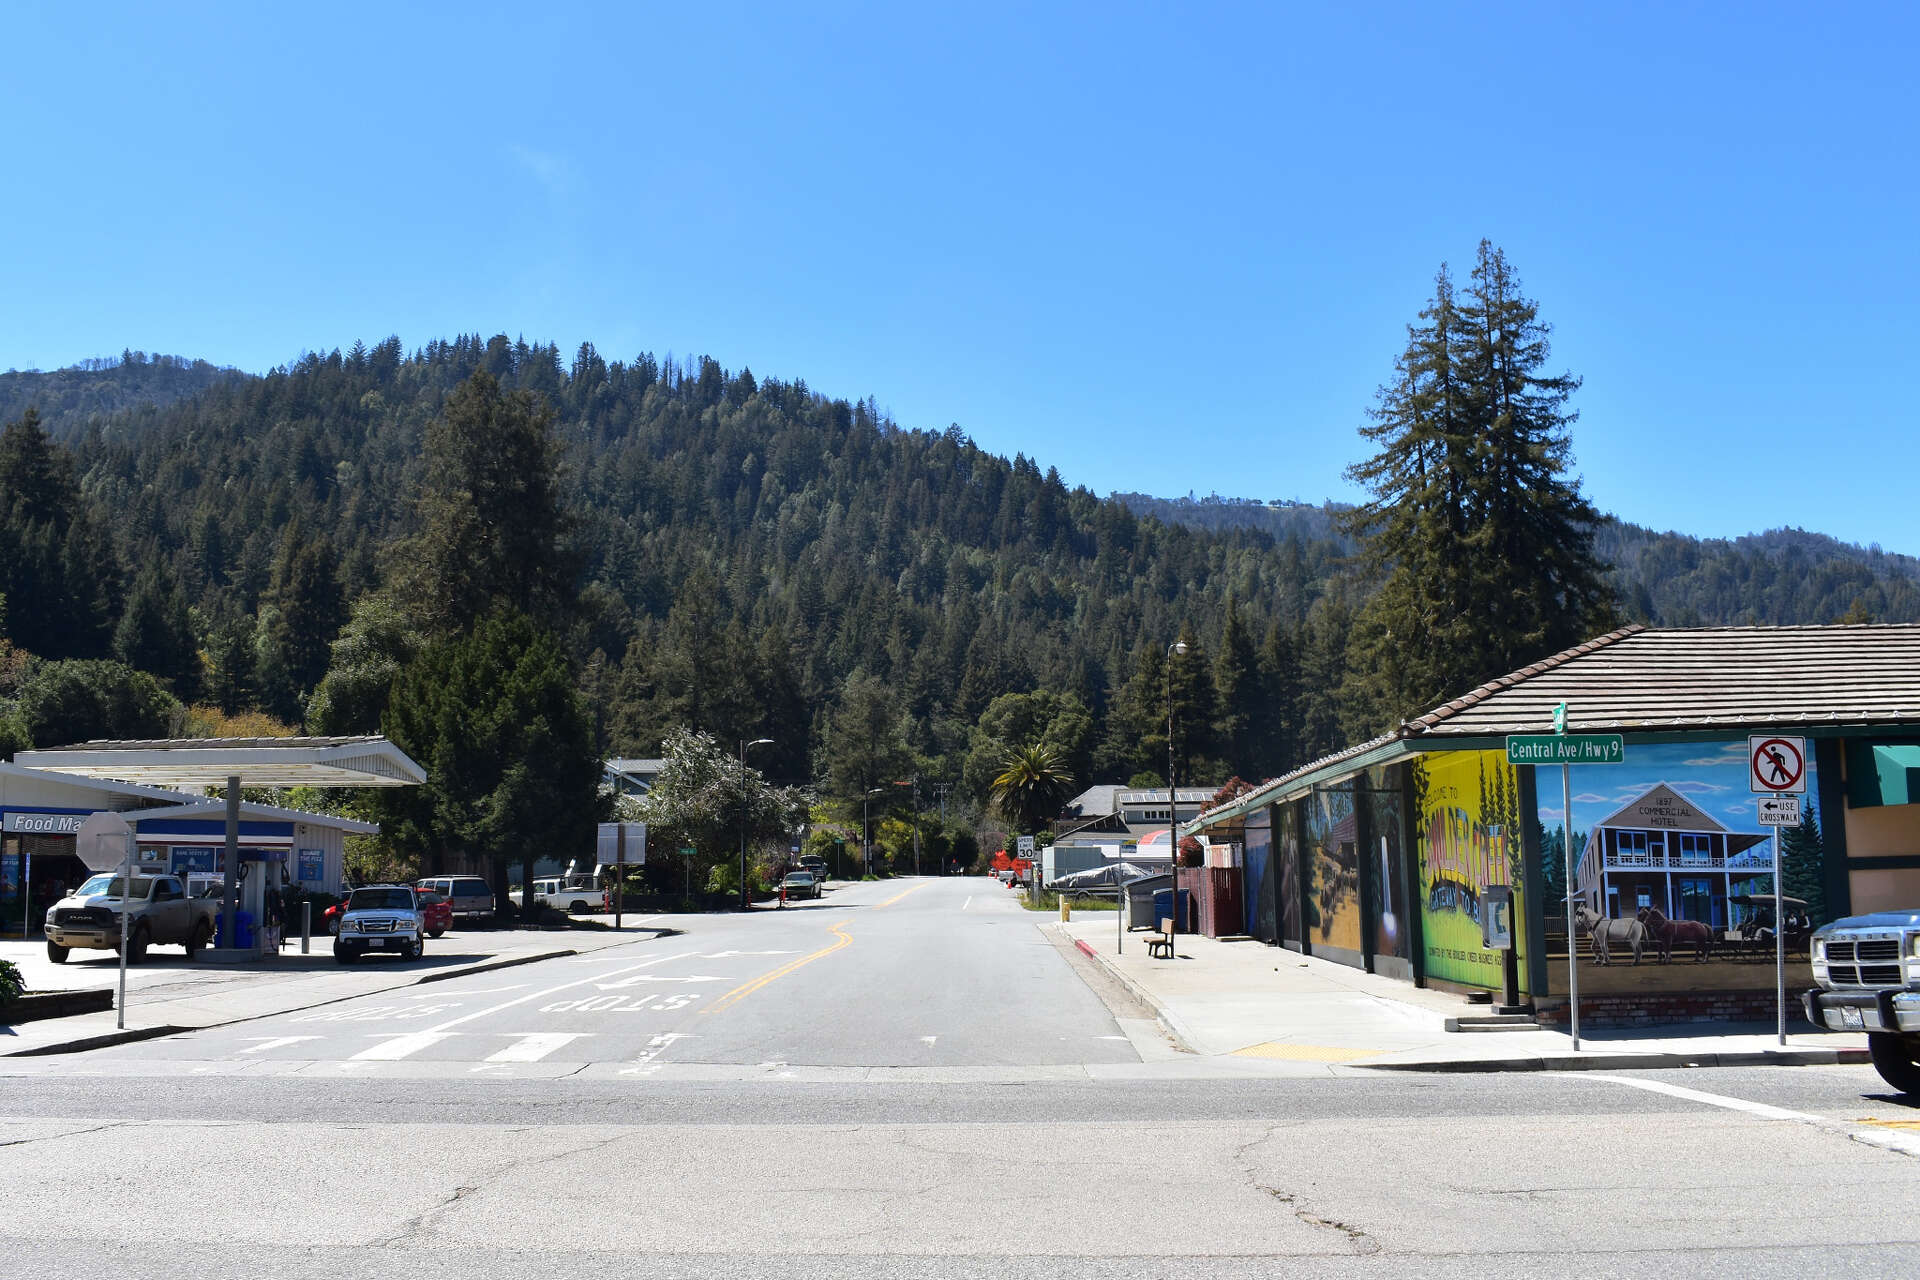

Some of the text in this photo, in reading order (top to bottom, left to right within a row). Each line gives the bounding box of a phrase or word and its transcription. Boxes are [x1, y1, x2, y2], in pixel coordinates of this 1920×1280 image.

[1511, 741, 1619, 760] Central Ave/Hwy 9
[1449, 786, 1458, 800] TO
[1639, 807, 1692, 817] COMMERCIAL
[1779, 801, 1795, 811] USE
[14, 816, 81, 831] Food Ma
[1650, 817, 1679, 827] HOTEL
[1760, 813, 1798, 822] CROSSWALK
[1019, 849, 1033, 858] 30
[1431, 887, 1457, 911] GATEWAY
[1460, 890, 1471, 915] TO
[538, 993, 701, 1013] STOP
